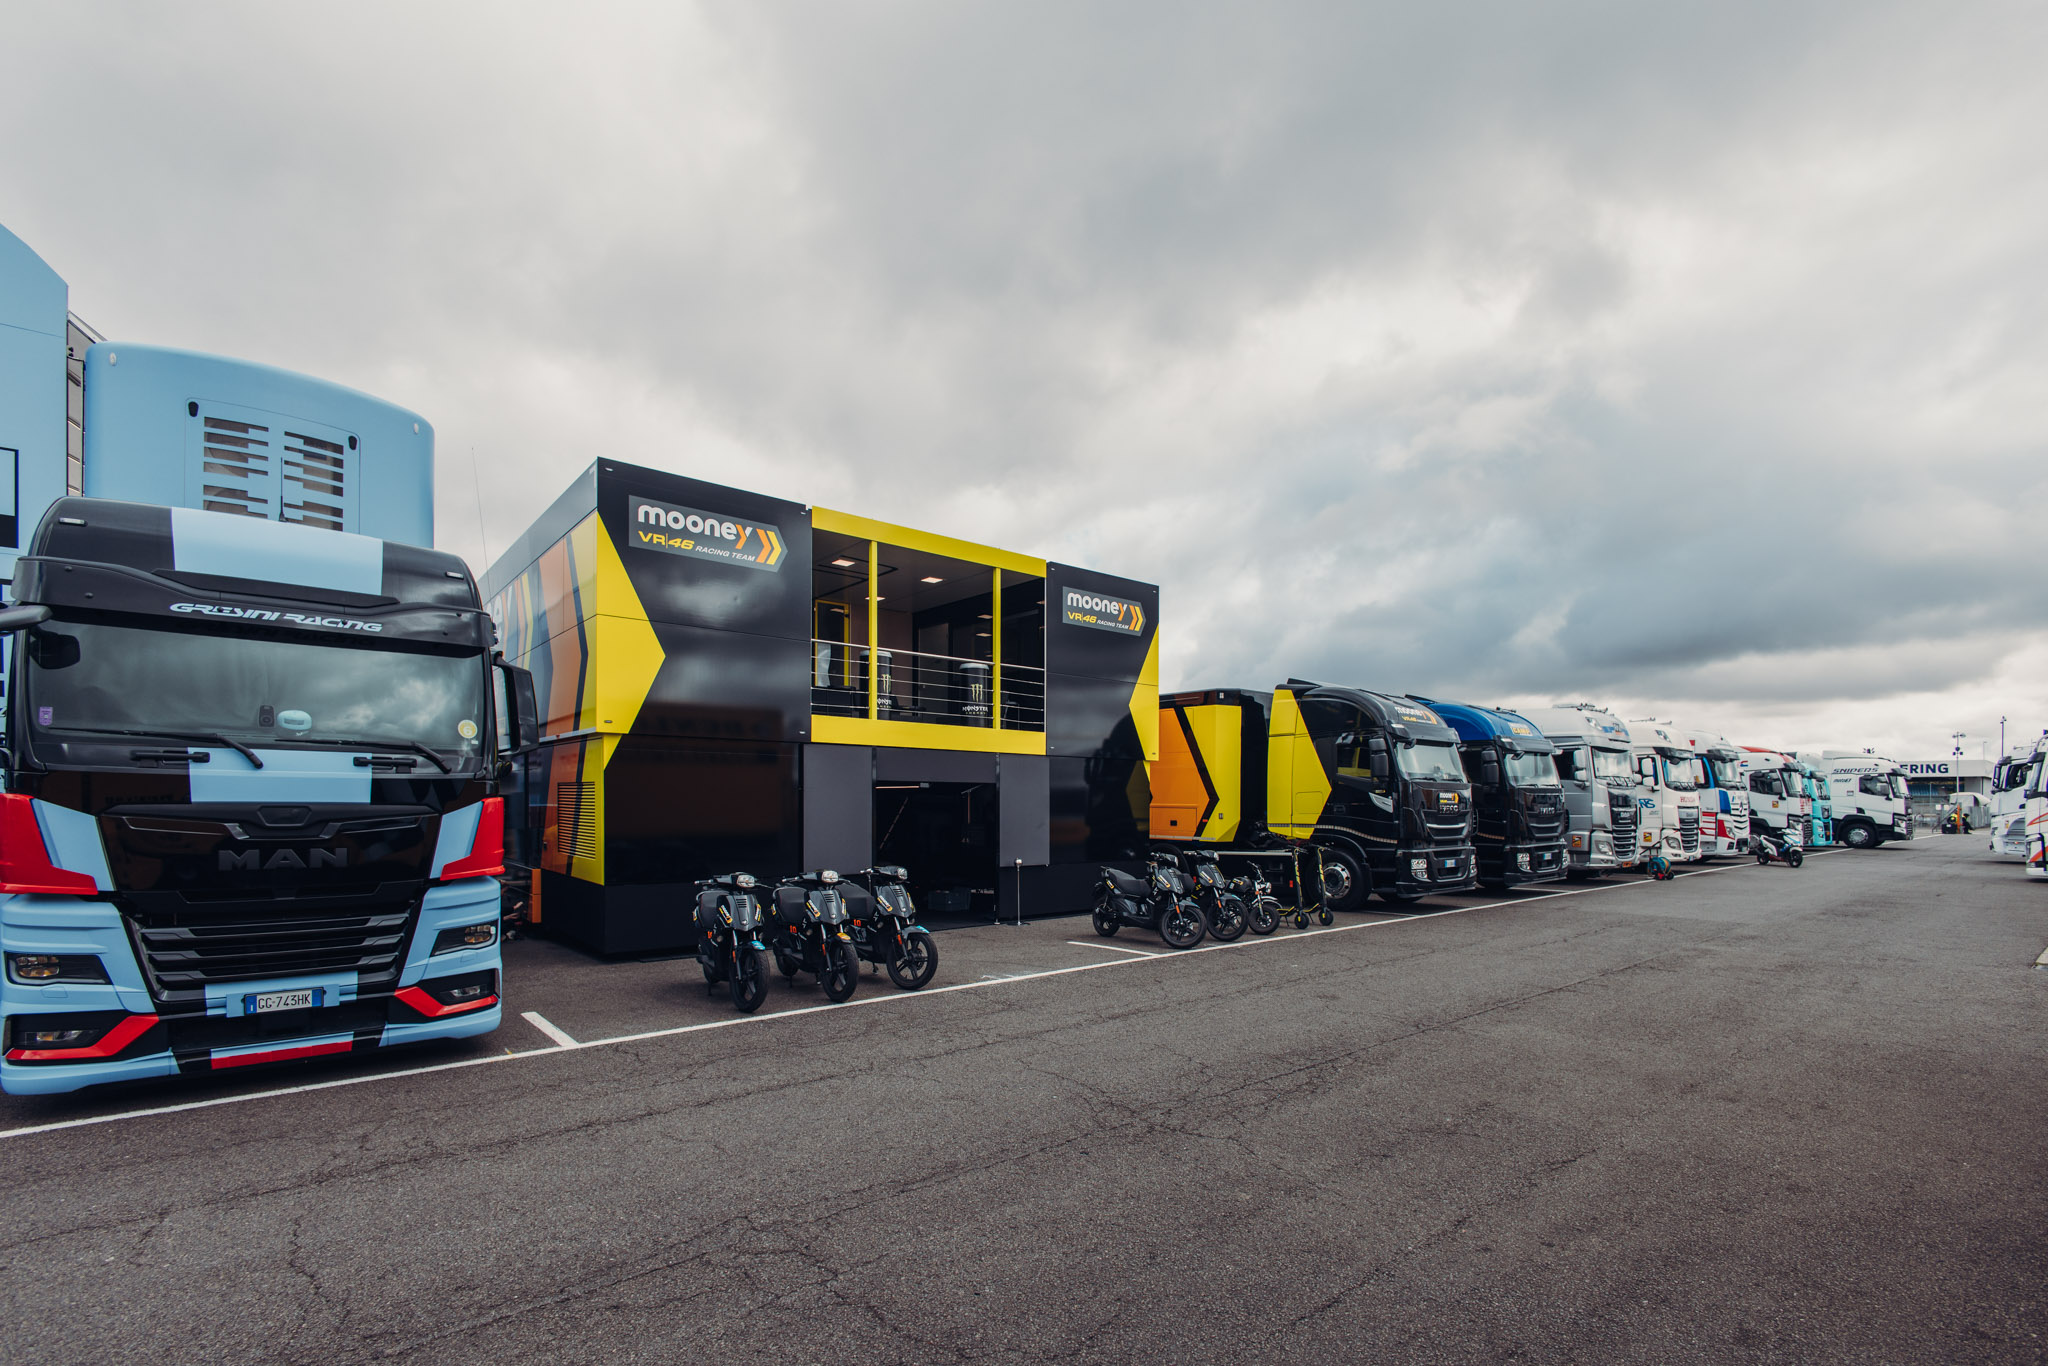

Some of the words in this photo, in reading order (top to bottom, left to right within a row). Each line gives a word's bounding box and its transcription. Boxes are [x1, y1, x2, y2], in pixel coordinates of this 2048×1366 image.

[638, 504, 753, 549] mooney
[695, 545, 730, 558] RACING
[731, 551, 756, 562] TEAM
[169, 602, 282, 621] GRESINI
[282, 612, 383, 632] RACING
[1067, 592, 1128, 622] mooney
[1096, 619, 1116, 627] RACING
[1115, 622, 1130, 630] TEAM
[218, 848, 348, 871] MAN
